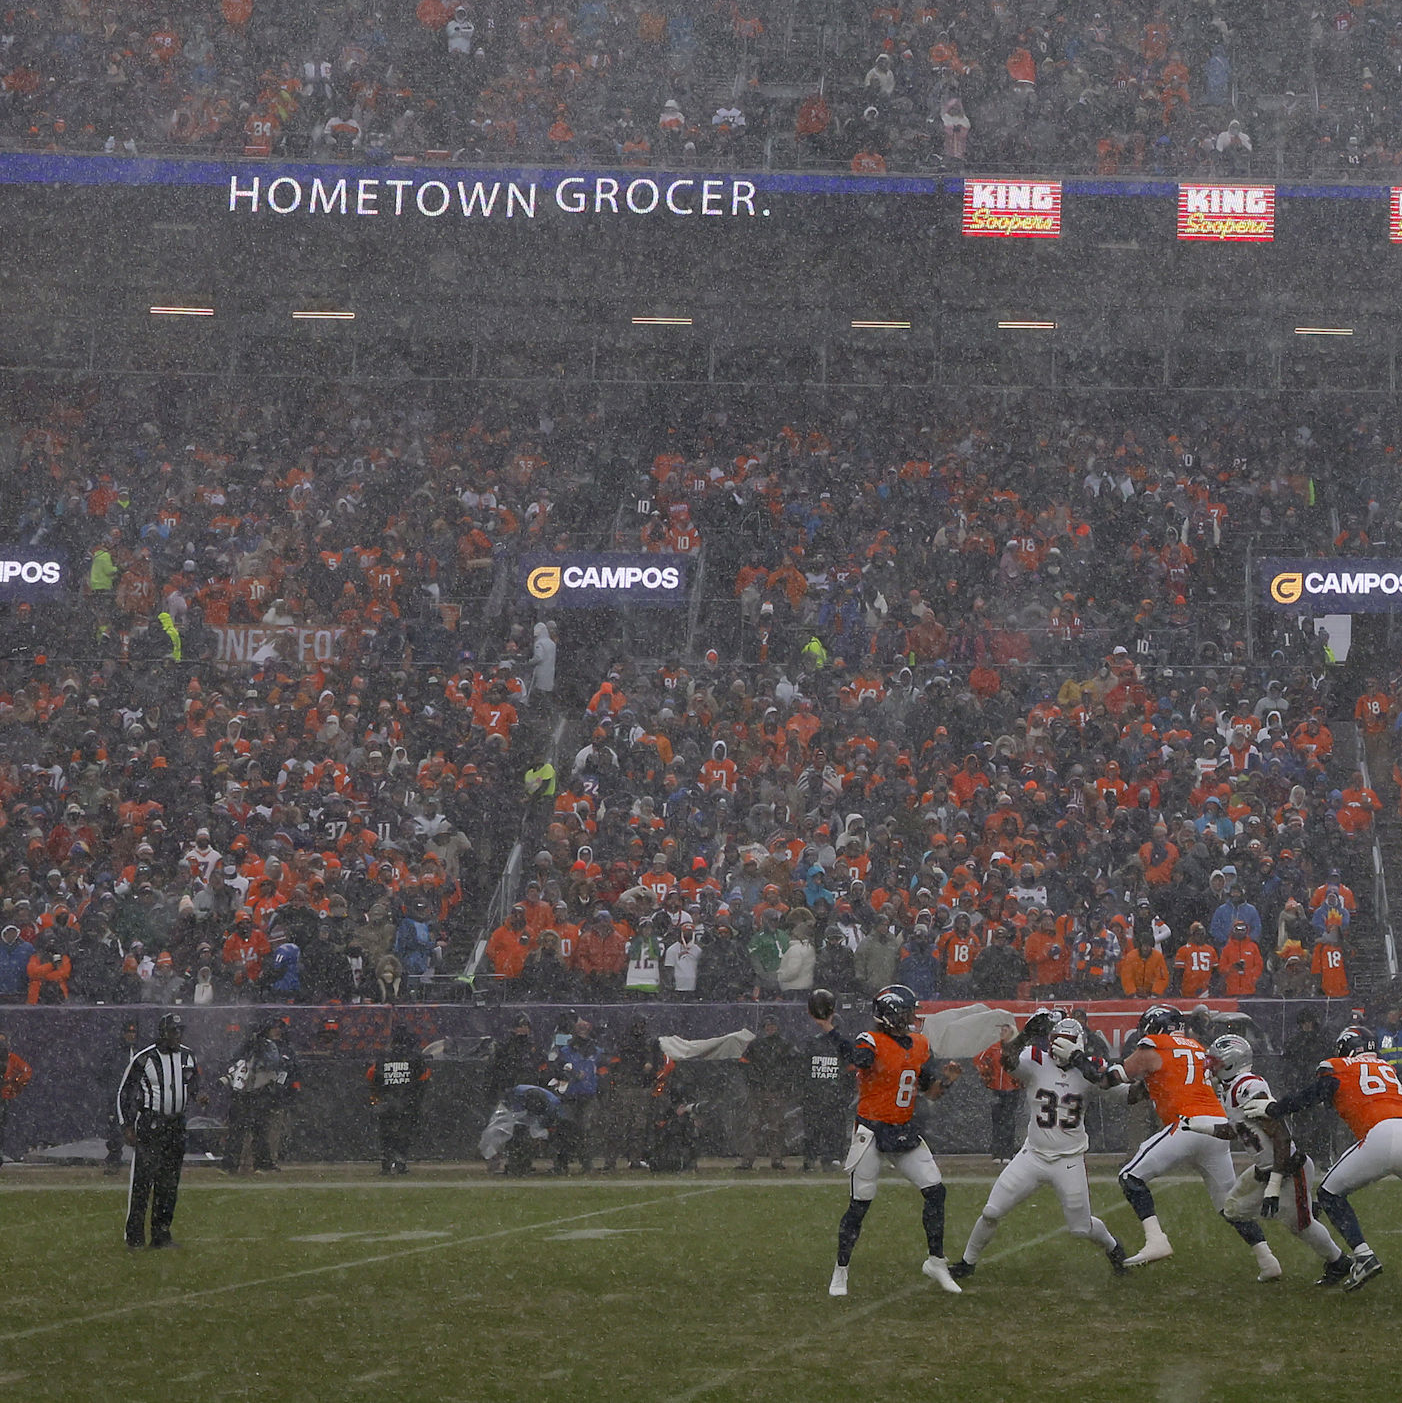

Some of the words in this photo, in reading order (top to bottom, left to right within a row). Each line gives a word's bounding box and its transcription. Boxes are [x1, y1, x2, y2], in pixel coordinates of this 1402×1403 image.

[229, 175, 538, 218] HOMETOWN
[555, 176, 771, 216] GROCER.
[972, 185, 1053, 209] KING
[1186, 187, 1266, 213] KING
[638, 500, 650, 513] 10
[677, 536, 689, 550] 10
[0, 561, 60, 583] POS
[563, 567, 679, 589] CAMPOS
[490, 711, 501, 727] 7
[954, 945, 969, 963] 18
[1191, 952, 1210, 971] 15
[1327, 951, 1341, 968] 18
[812, 1057, 838, 1067] argus
[895, 1069, 917, 1108] 8
[1035, 1088, 1084, 1130] 33
